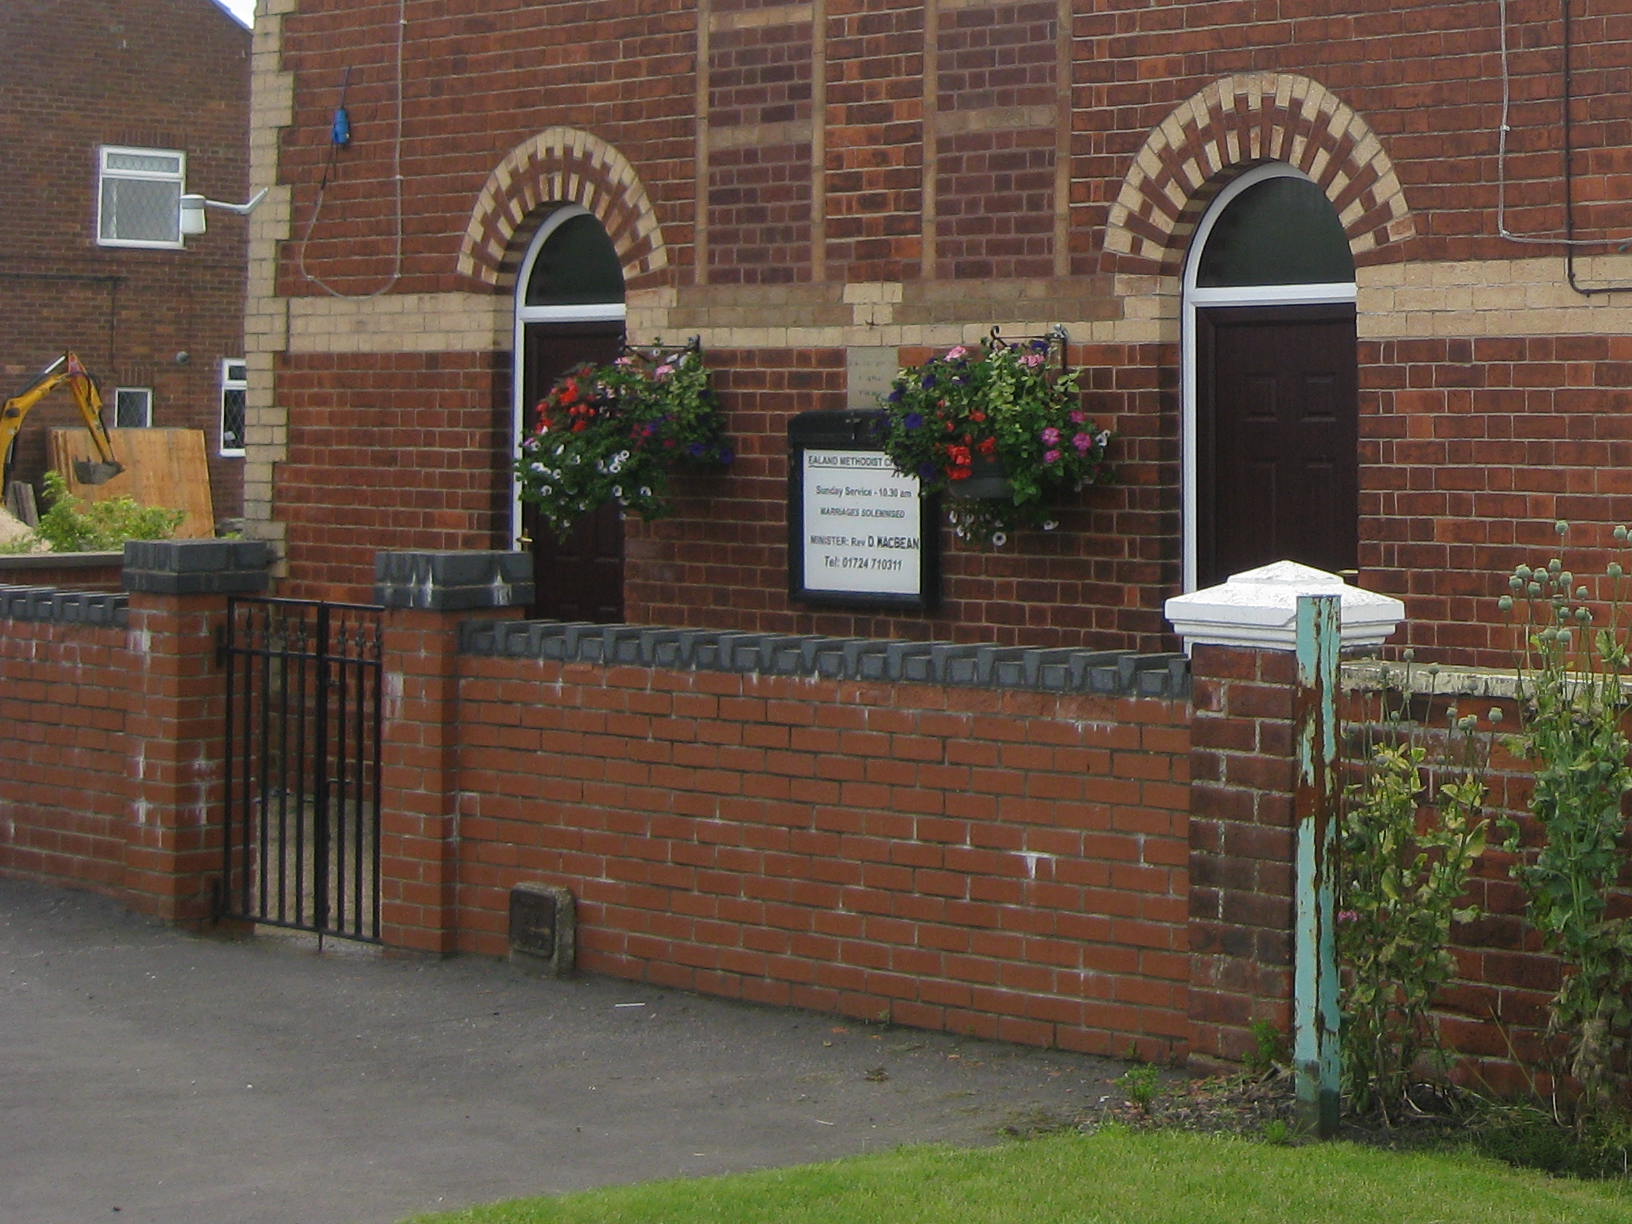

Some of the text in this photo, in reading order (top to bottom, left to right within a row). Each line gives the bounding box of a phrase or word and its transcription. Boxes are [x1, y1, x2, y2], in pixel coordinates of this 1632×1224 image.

[808, 456, 838, 465] EALAND
[839, 457, 882, 467] METHODIST
[816, 485, 843, 498] Sunday
[845, 486, 872, 497] Service
[879, 487, 898, 498] 10.30
[900, 490, 912, 498] am
[820, 507, 905, 519] MARRIAGES SOLEMNISED
[811, 535, 849, 546] MINISTER:
[851, 537, 866, 547] Rev
[877, 536, 919, 550] MACBEAN
[825, 556, 902, 571] Tel: 01724 710311
